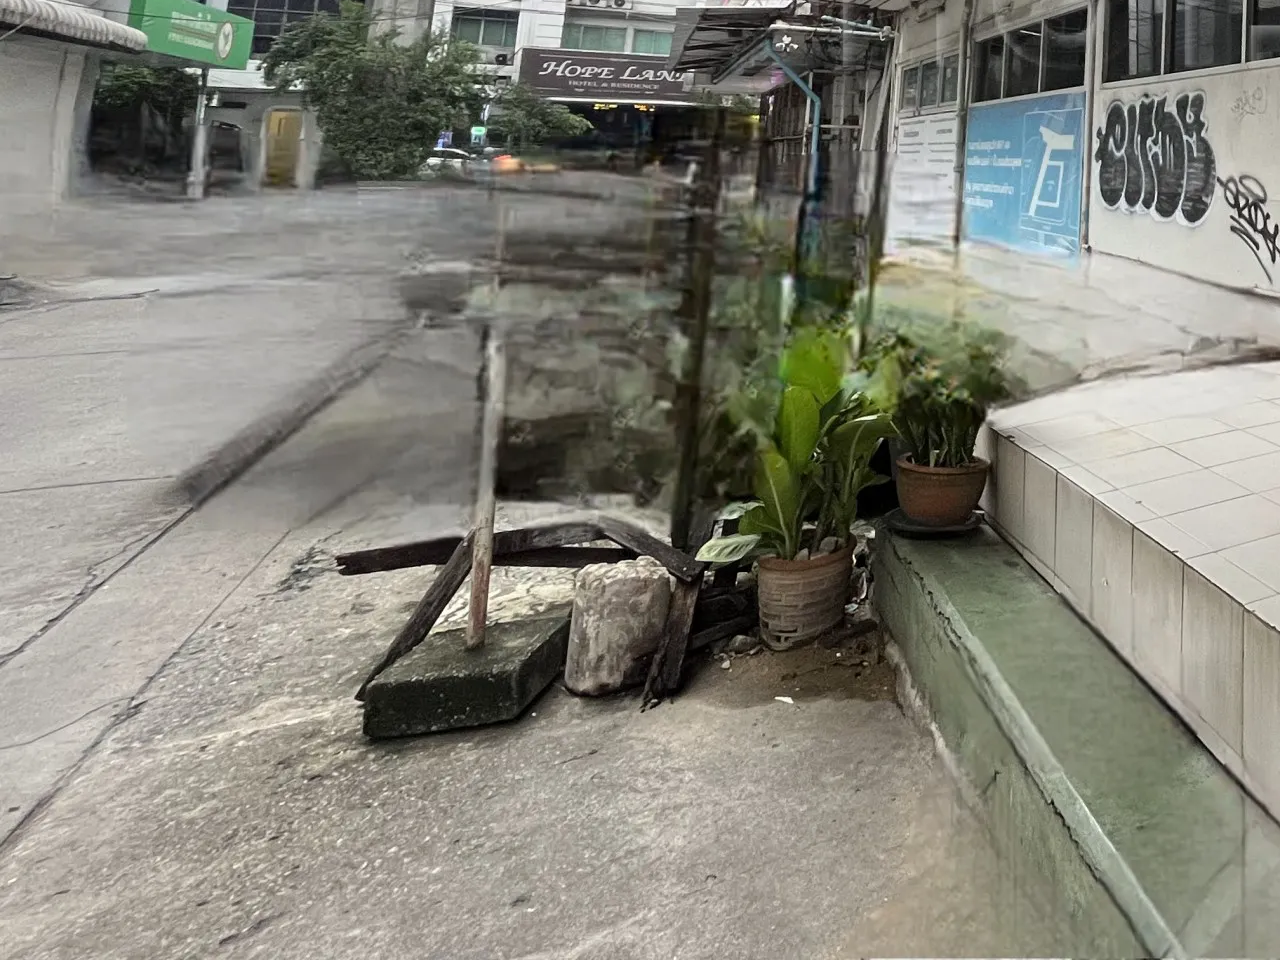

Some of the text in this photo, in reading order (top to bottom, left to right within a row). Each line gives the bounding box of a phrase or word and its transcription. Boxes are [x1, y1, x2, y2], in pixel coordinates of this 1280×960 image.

[538, 60, 615, 79] HOPE
[568, 80, 598, 88] HOTEL
[610, 82, 660, 90] RESIDENCE
